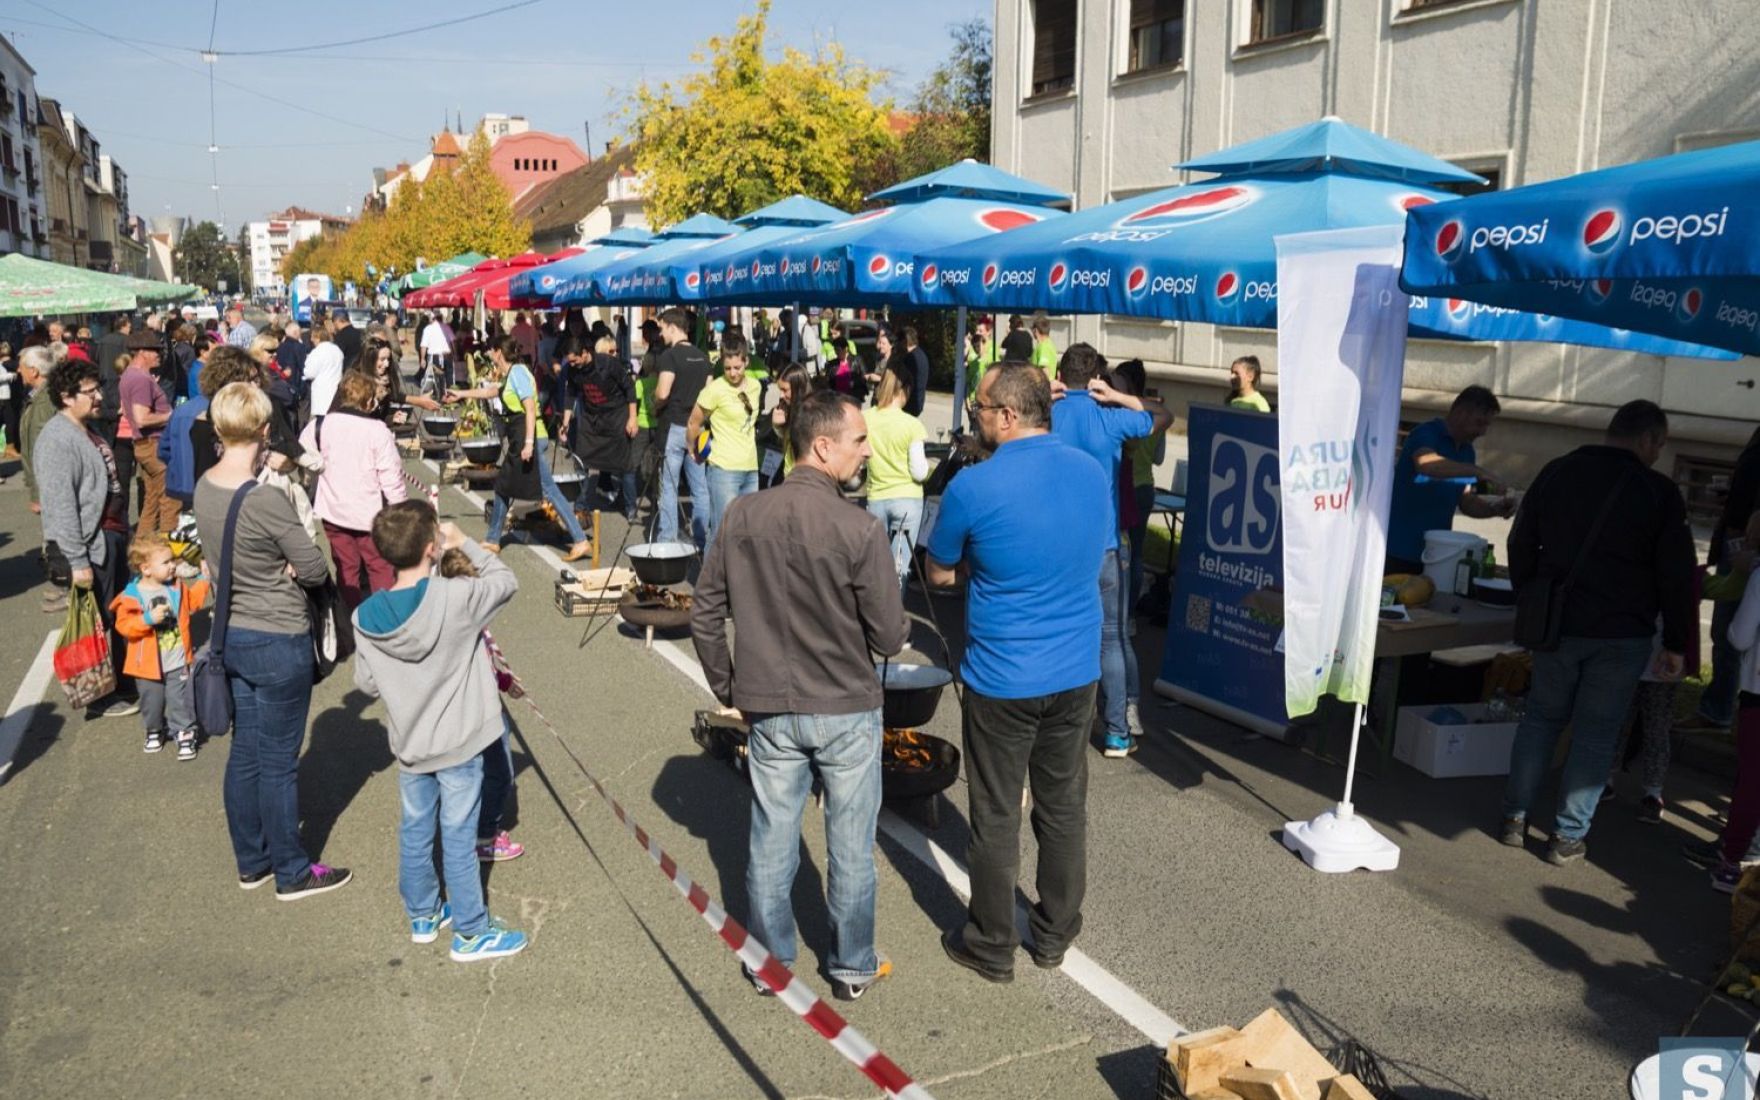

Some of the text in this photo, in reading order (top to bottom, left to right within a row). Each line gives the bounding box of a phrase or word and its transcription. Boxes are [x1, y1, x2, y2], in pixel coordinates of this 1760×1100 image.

[1470, 207, 1729, 253] pepsi pepsi
[940, 267, 1278, 303] pepsi pepsi pepsi pepsi pep
[1209, 440, 1281, 550] as
[1199, 552, 1274, 590] televizija
